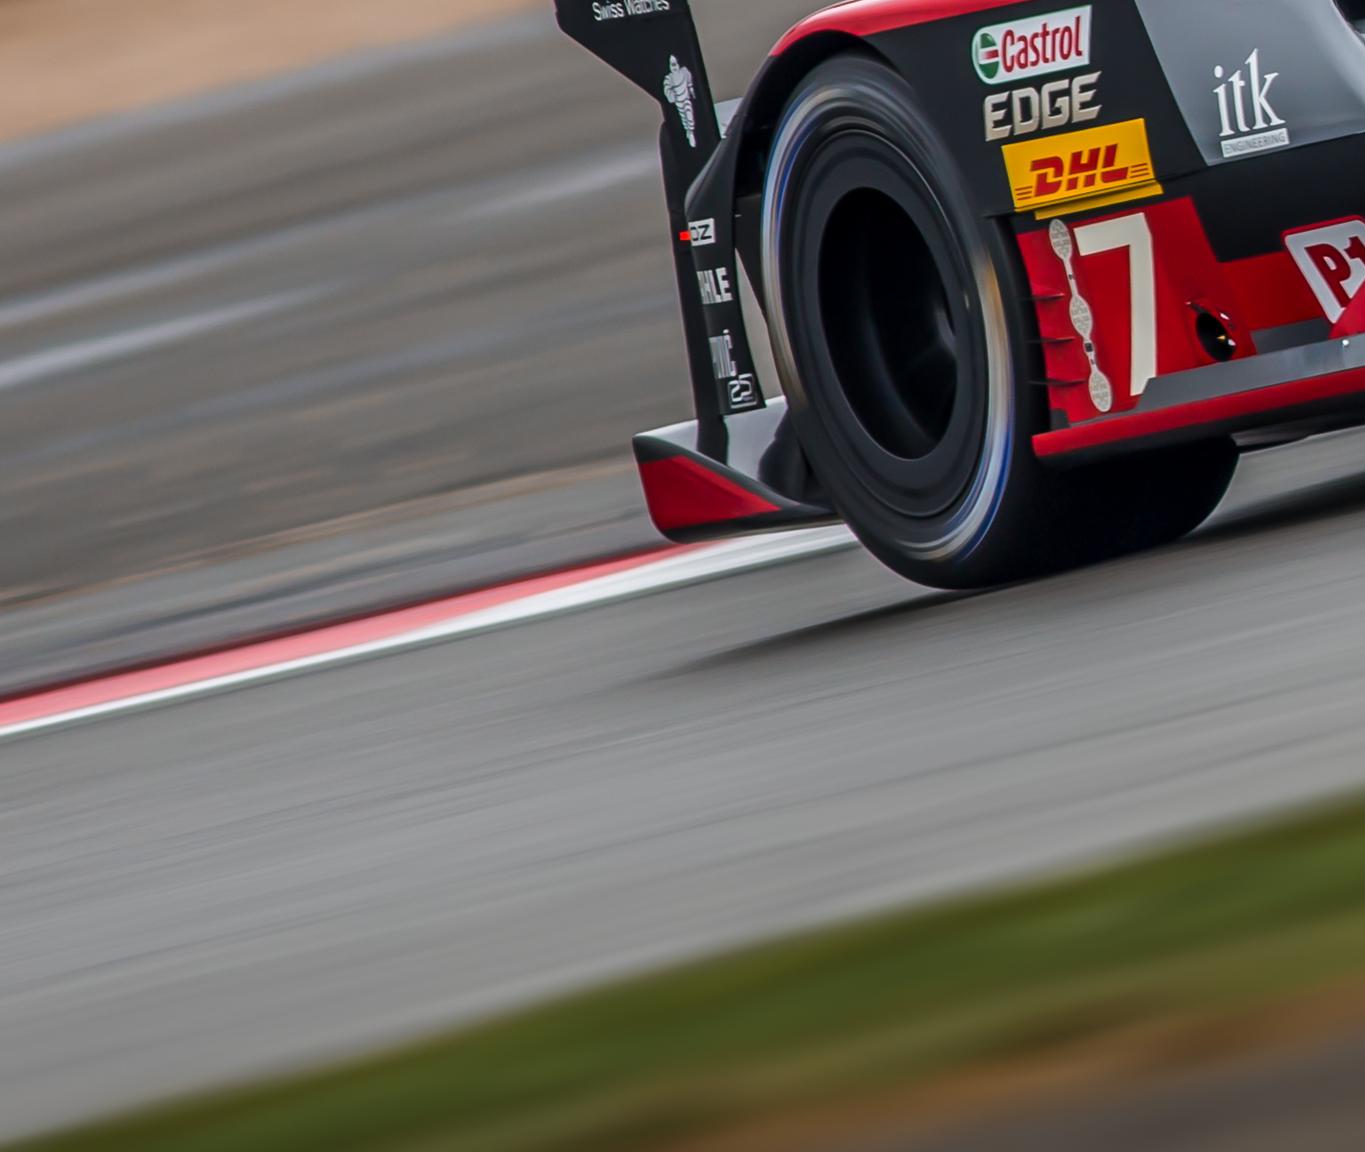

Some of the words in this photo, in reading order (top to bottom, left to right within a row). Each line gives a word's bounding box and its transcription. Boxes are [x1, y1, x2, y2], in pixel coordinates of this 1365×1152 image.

[592, 0, 625, 21] Swiss
[1002, 16, 1082, 74] Castrol
[984, 71, 1102, 141] EDGE
[1213, 48, 1286, 136] itk
[1030, 143, 1131, 198] DHL
[1073, 212, 1157, 396] 7
